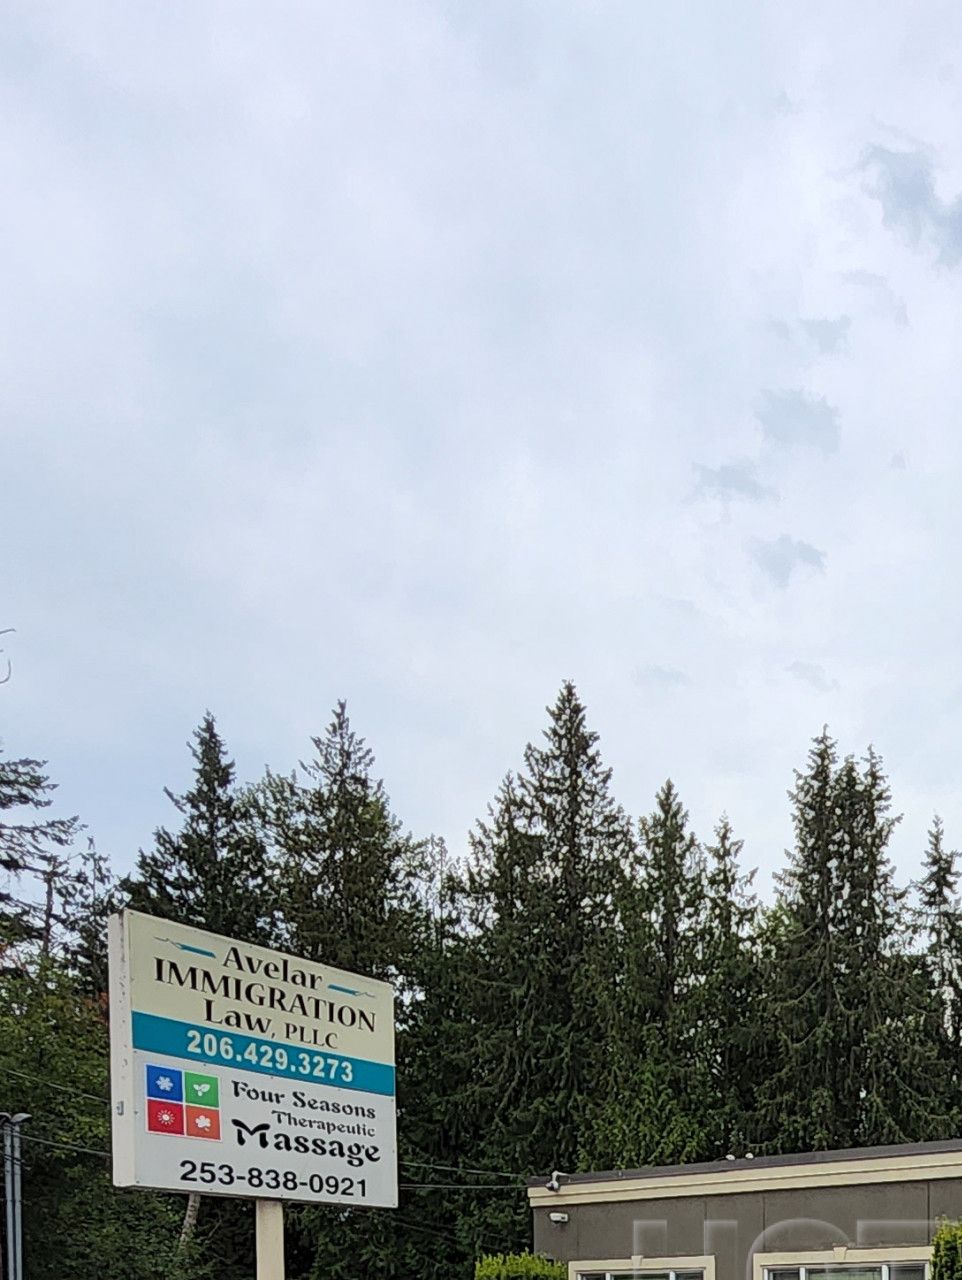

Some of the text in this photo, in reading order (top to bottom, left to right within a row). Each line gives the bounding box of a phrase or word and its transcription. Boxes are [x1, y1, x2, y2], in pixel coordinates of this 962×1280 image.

[222, 946, 323, 991] Avelar
[154, 957, 376, 1033] IMMIGRATION
[203, 998, 339, 1050] Law, PLLC
[187, 1029, 354, 1083] 206.429.3273
[231, 1080, 376, 1120] Four Seasons
[231, 1118, 381, 1168] Massage
[271, 1110, 376, 1138] Therapeutic
[180, 1160, 367, 1198] 253-838-0921
